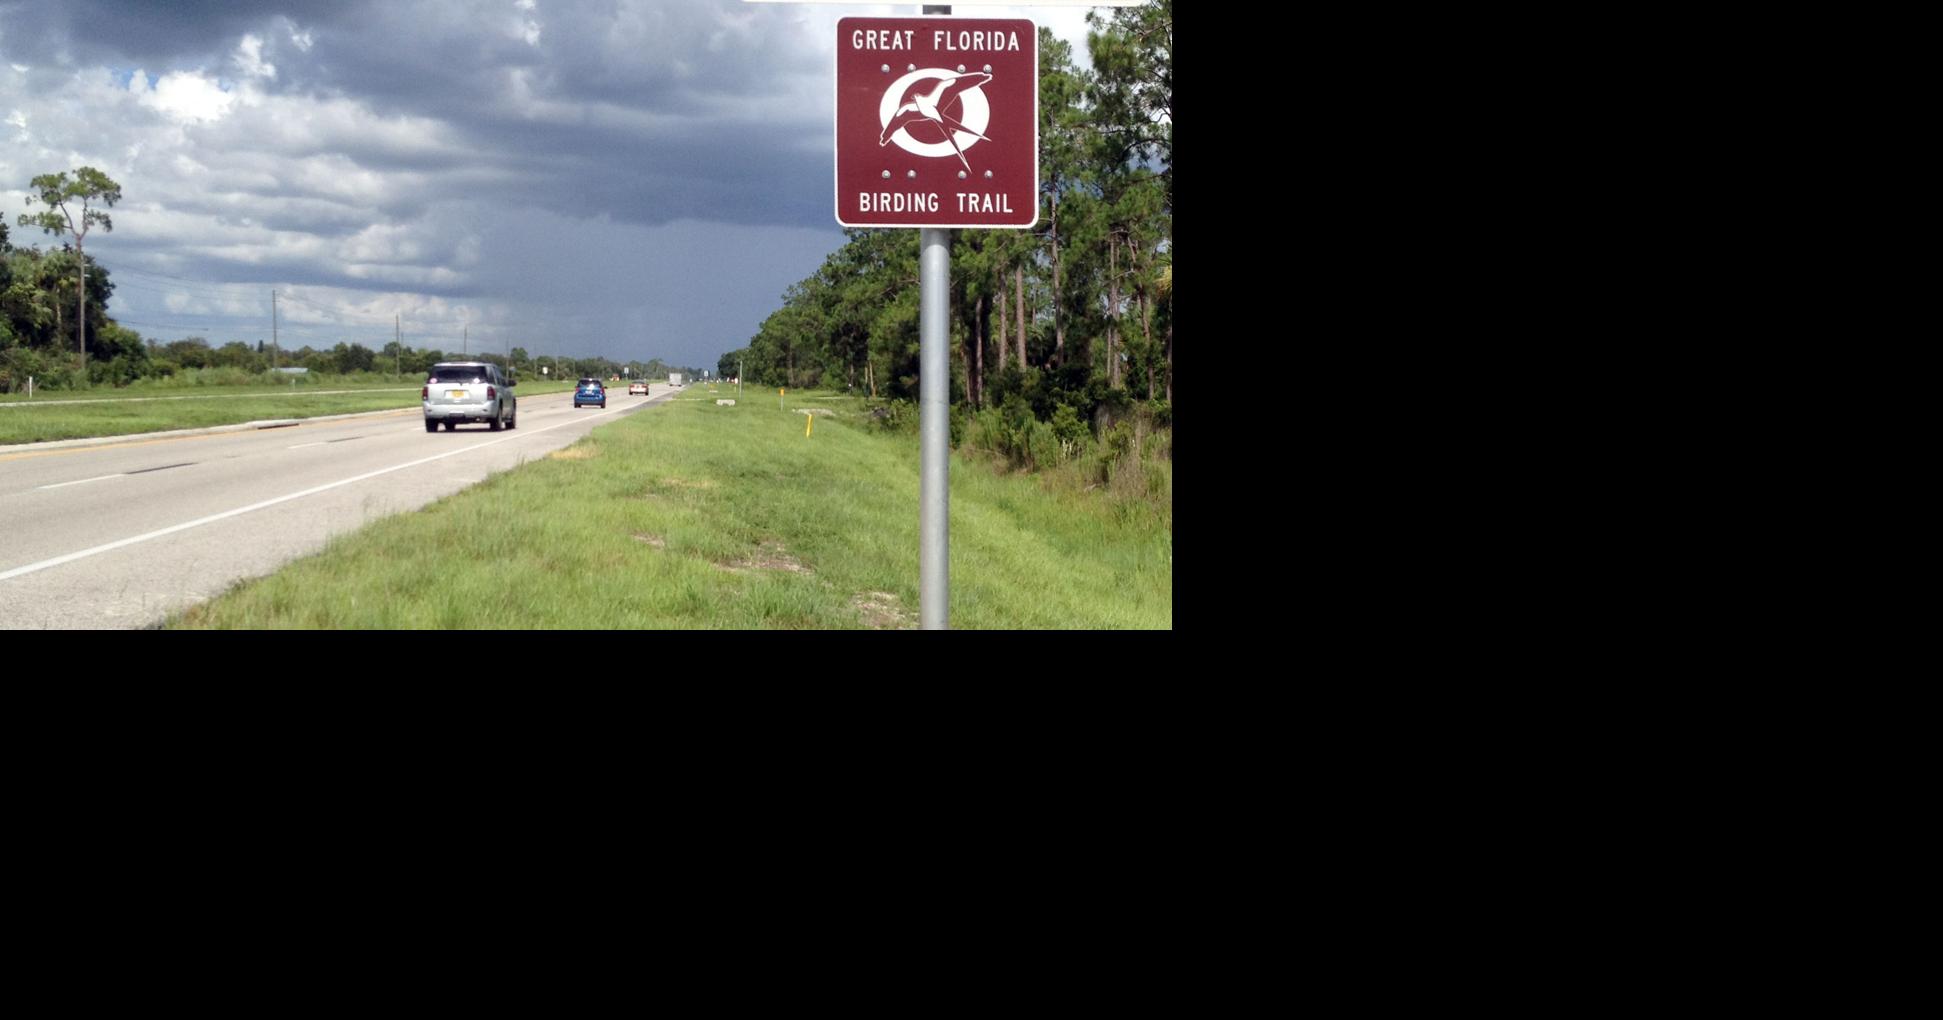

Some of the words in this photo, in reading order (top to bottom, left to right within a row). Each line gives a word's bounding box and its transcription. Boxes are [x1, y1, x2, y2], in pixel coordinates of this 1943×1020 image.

[852, 30, 914, 50] GREAT
[934, 31, 1020, 51] FLORIDA
[859, 192, 939, 212] BIRDING
[956, 193, 1013, 213] TRAIL
